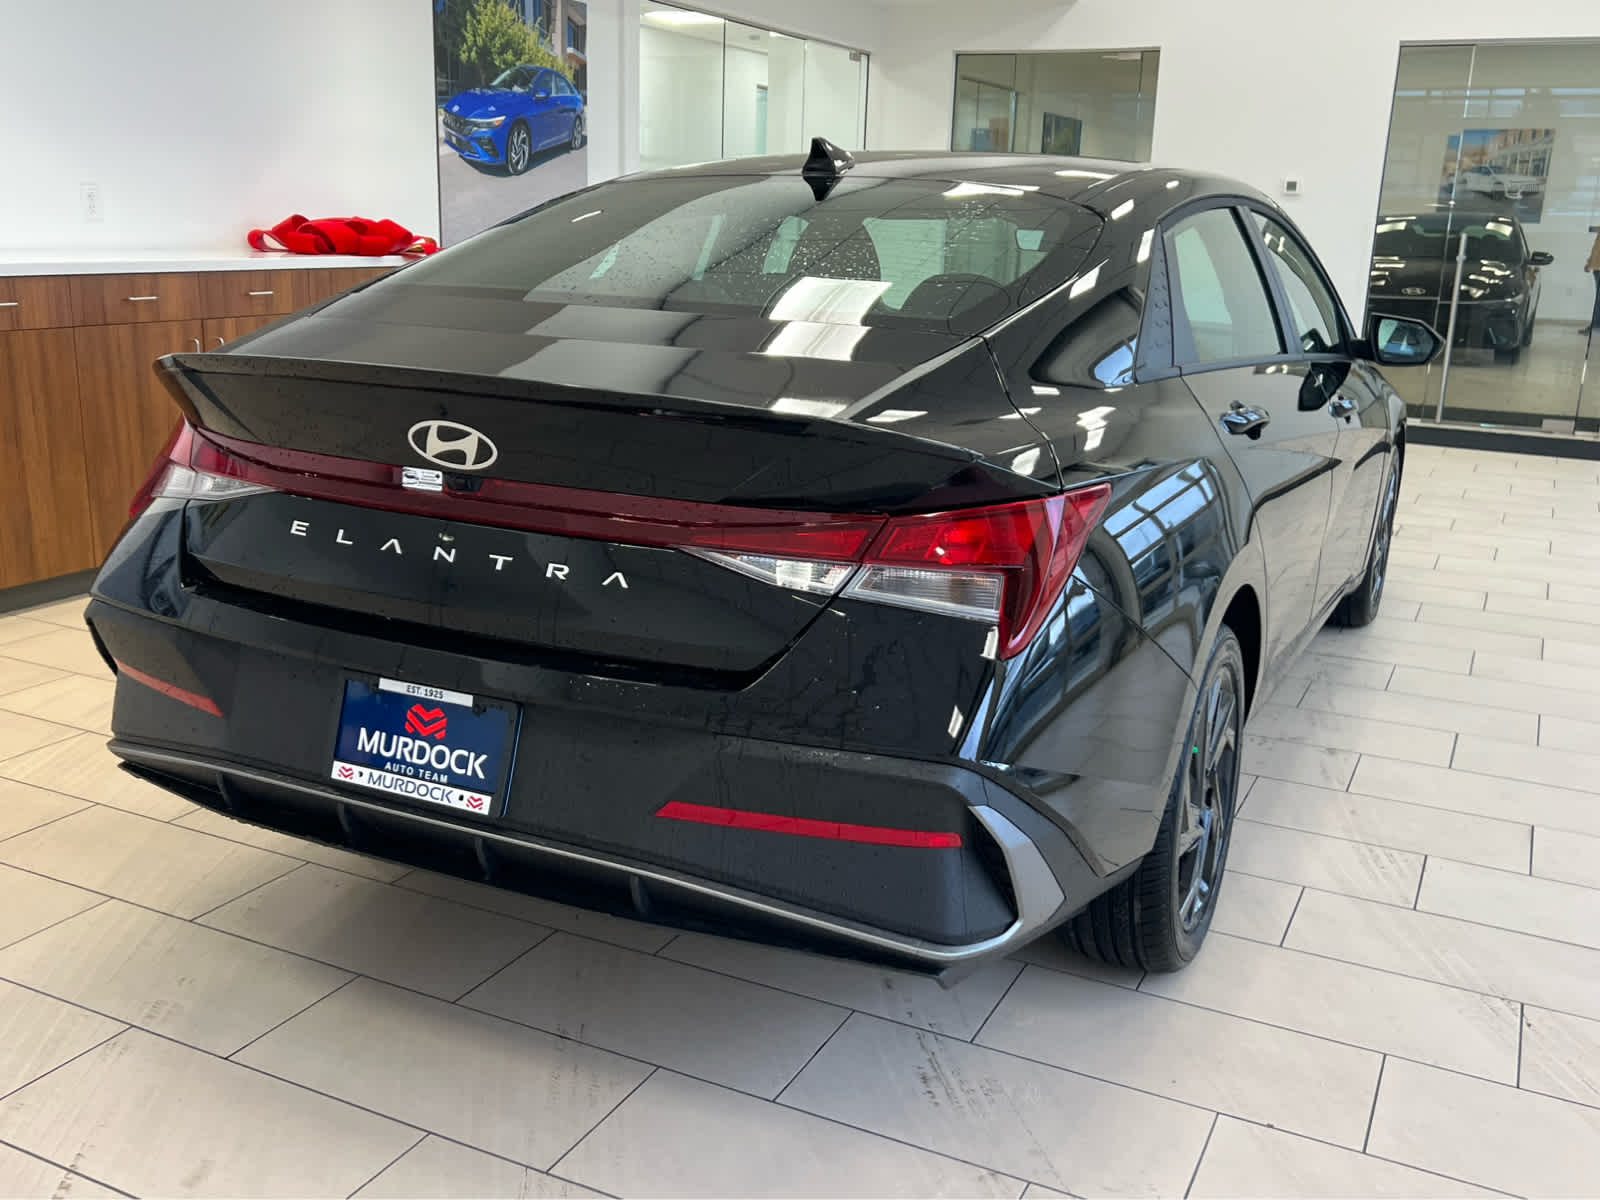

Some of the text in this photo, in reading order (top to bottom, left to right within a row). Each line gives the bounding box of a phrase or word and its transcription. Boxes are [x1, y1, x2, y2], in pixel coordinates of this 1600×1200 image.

[290, 520, 629, 589] ELANTRA
[406, 684, 444, 699] EST. 1925
[357, 727, 488, 780] MURDOCK
[367, 771, 453, 804] MURDOCK
[384, 762, 448, 784] AUTO TEAM
